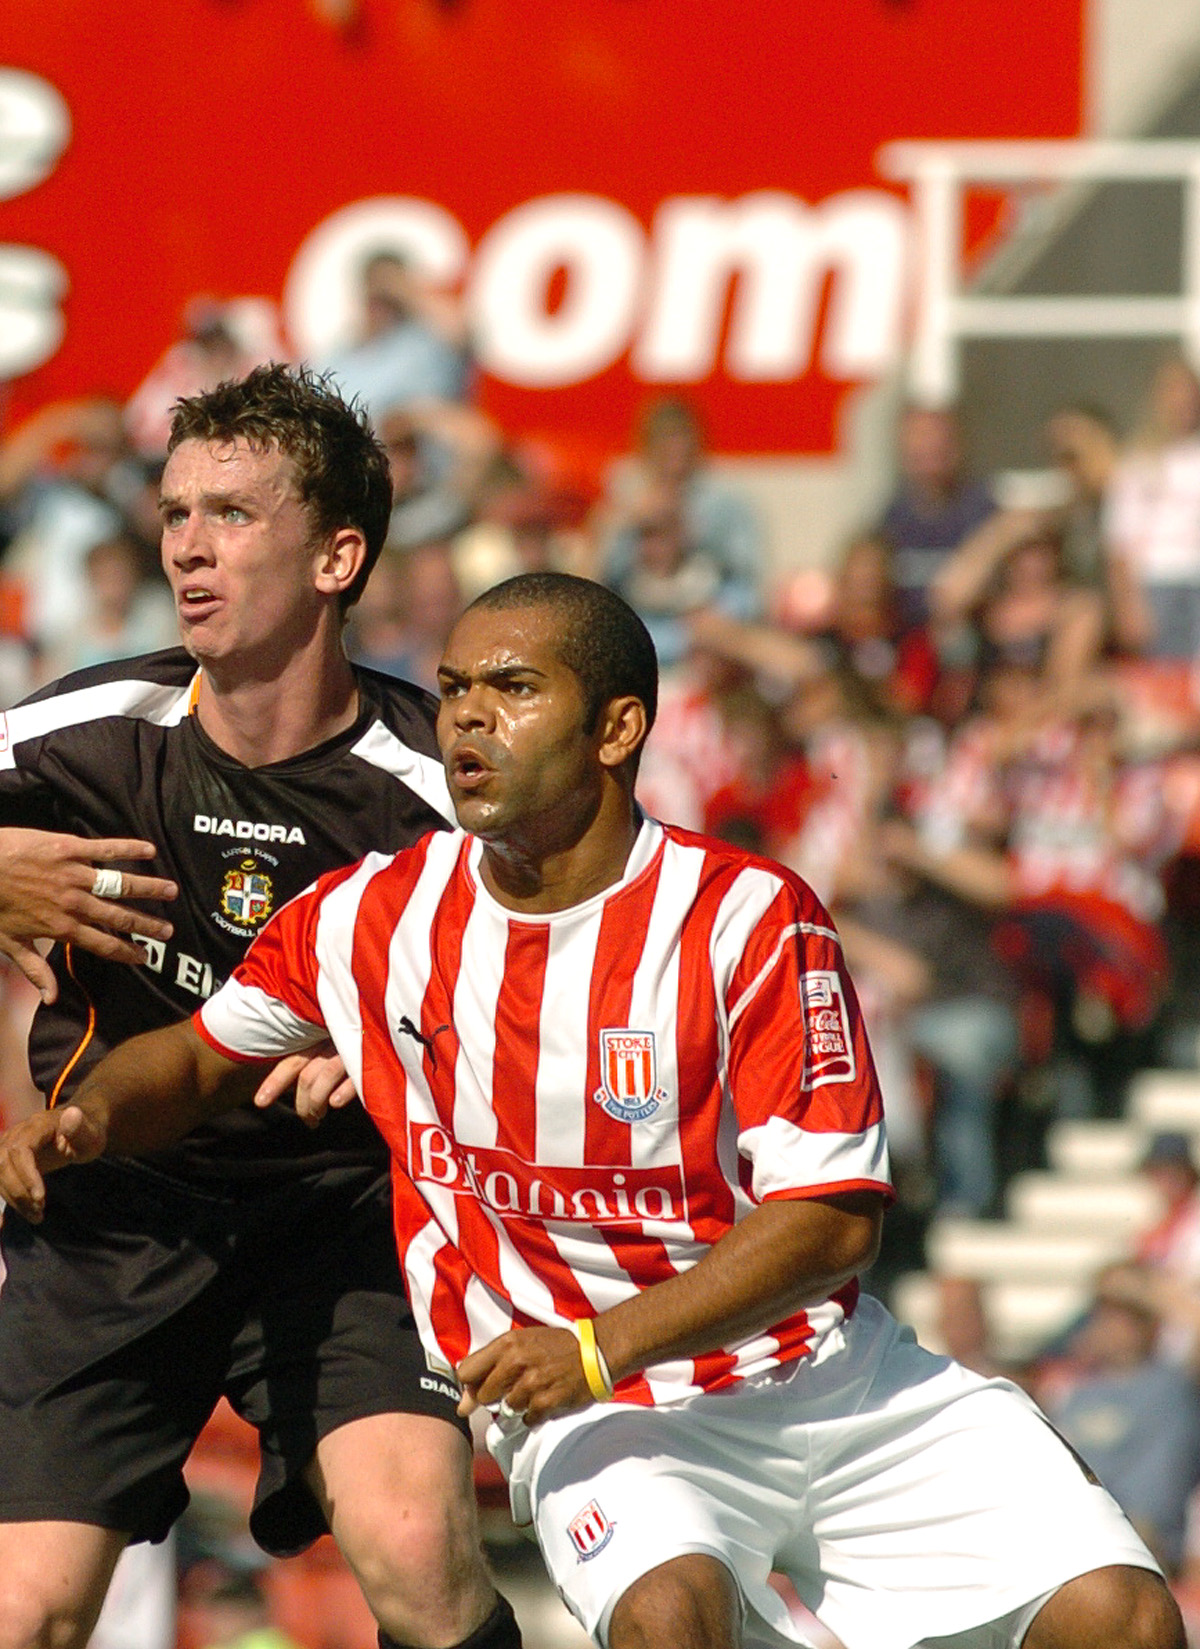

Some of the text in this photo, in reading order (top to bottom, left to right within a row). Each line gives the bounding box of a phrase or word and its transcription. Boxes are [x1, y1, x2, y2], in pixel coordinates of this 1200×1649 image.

[193, 814, 307, 846] DIADORA
[606, 1037, 652, 1050] STOKE
[618, 1050, 641, 1059] CITY
[419, 1127, 677, 1220] Btannia
[420, 1376, 463, 1402] DIAD
